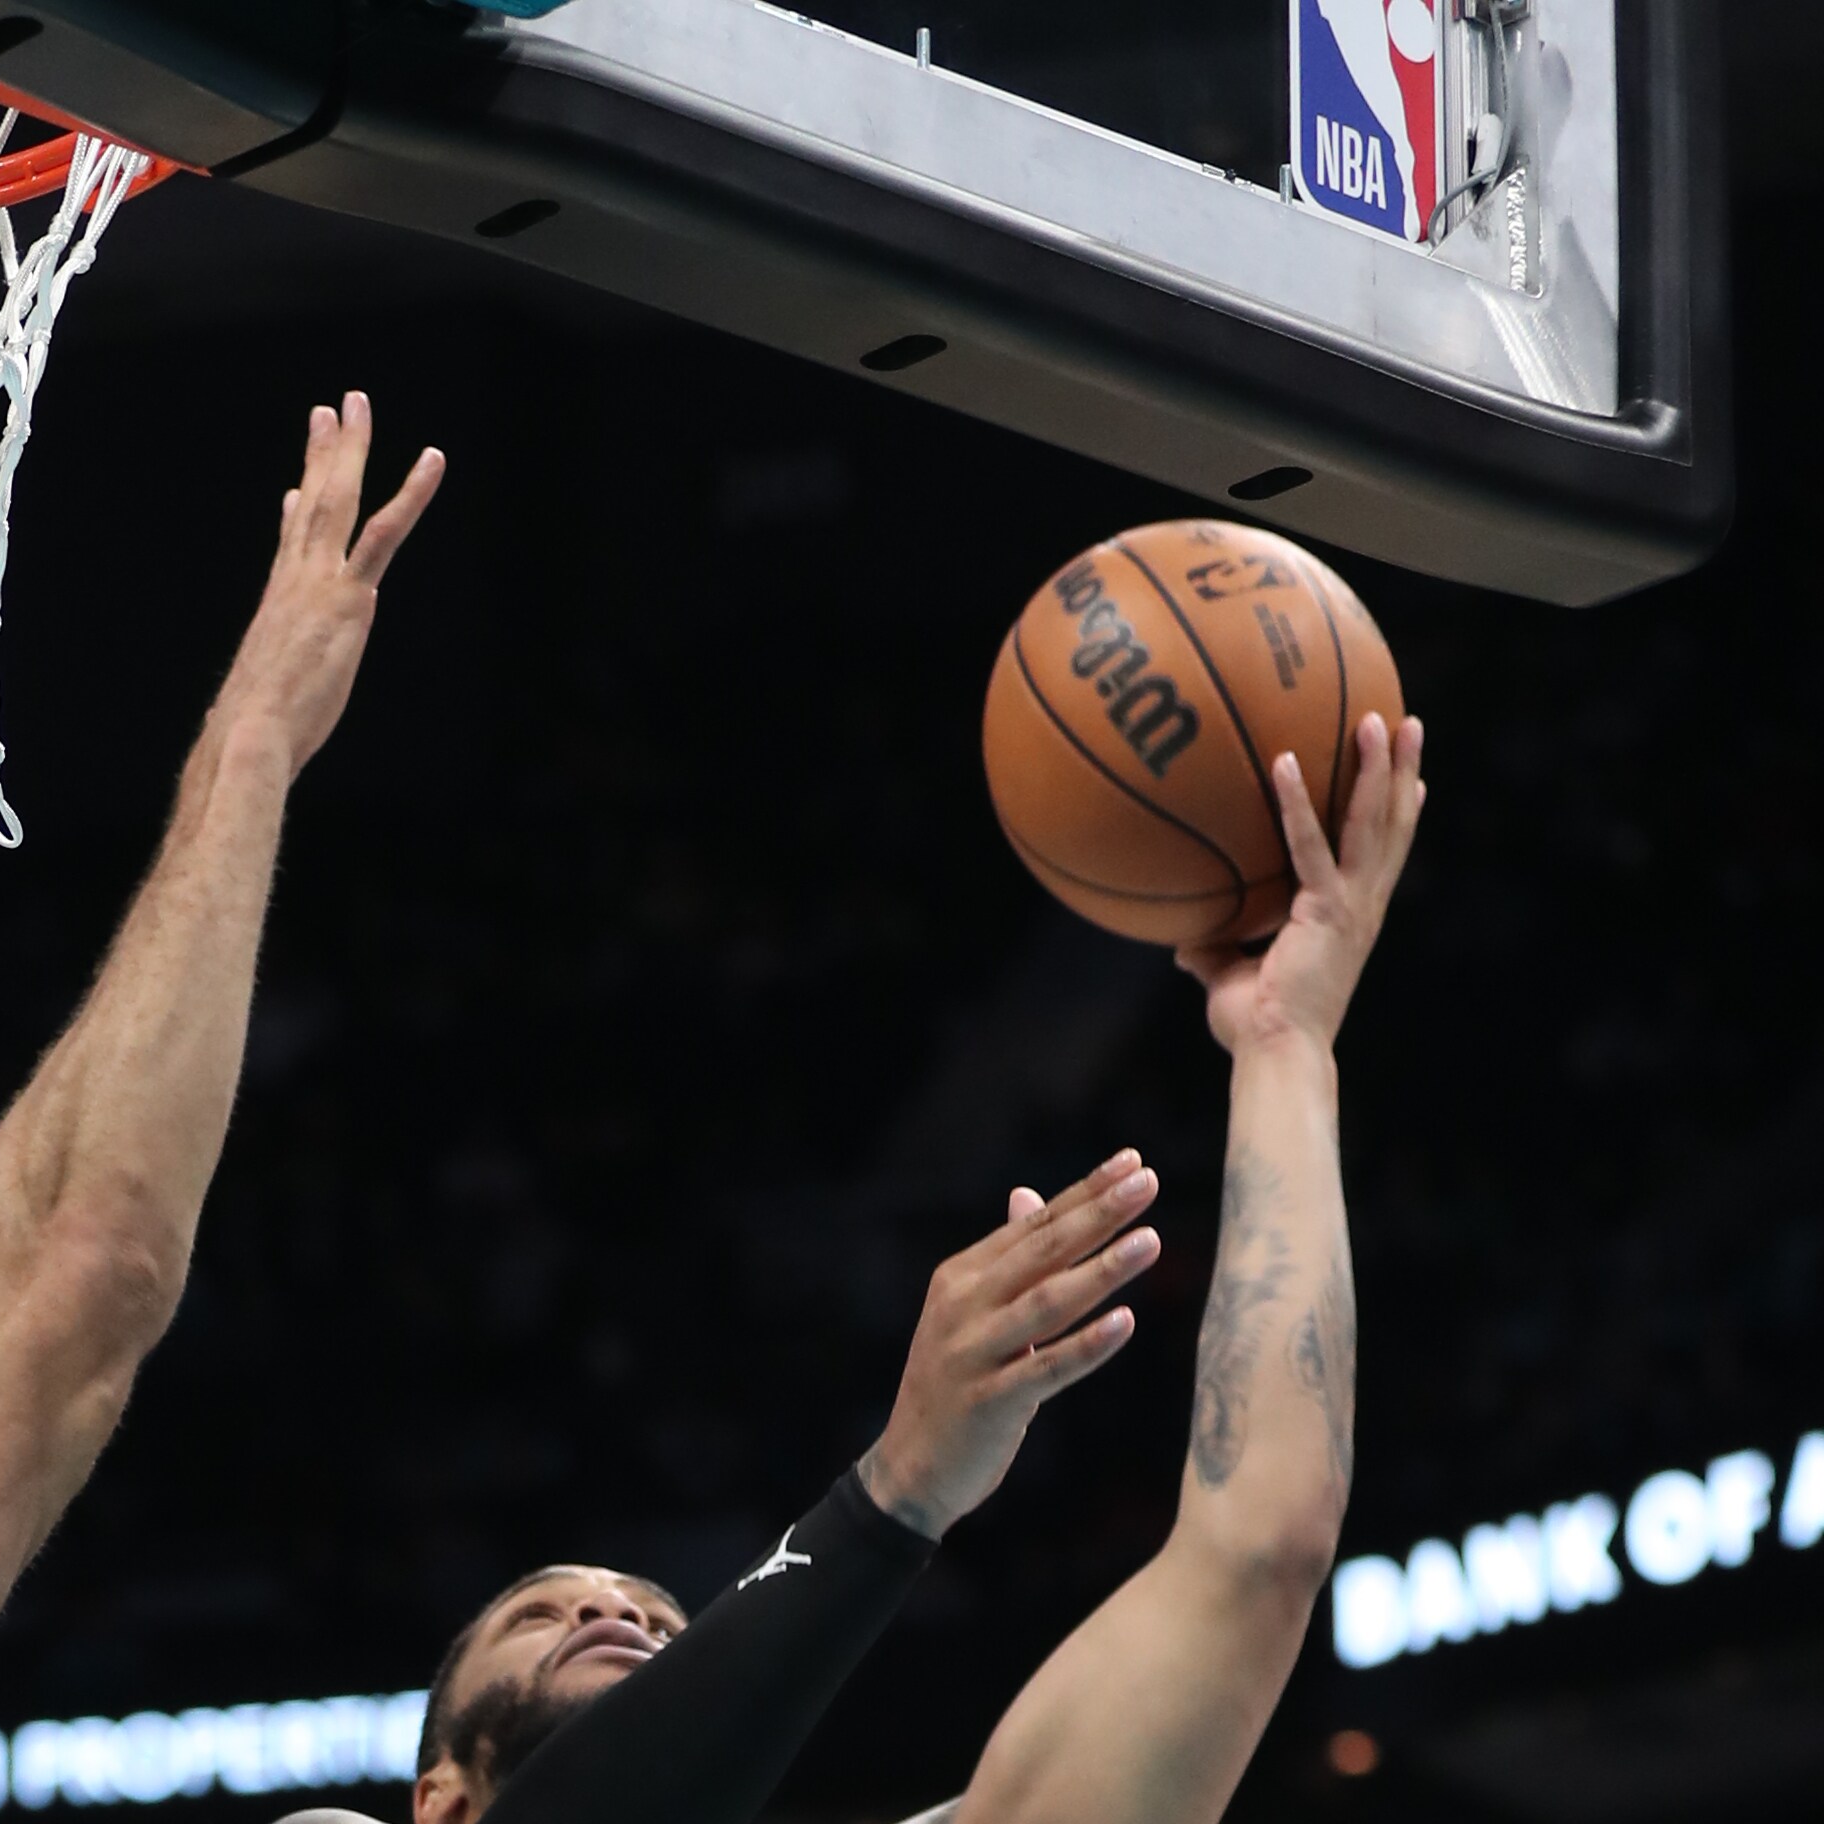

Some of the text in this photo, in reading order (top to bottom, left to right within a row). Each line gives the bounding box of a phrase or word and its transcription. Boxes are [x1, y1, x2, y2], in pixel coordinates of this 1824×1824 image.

[1315, 114, 1388, 212] NBA
[1054, 557, 1202, 781] Wilson
[1332, 1491, 1623, 1670] BANK
[1625, 1449, 1776, 1586] OF
